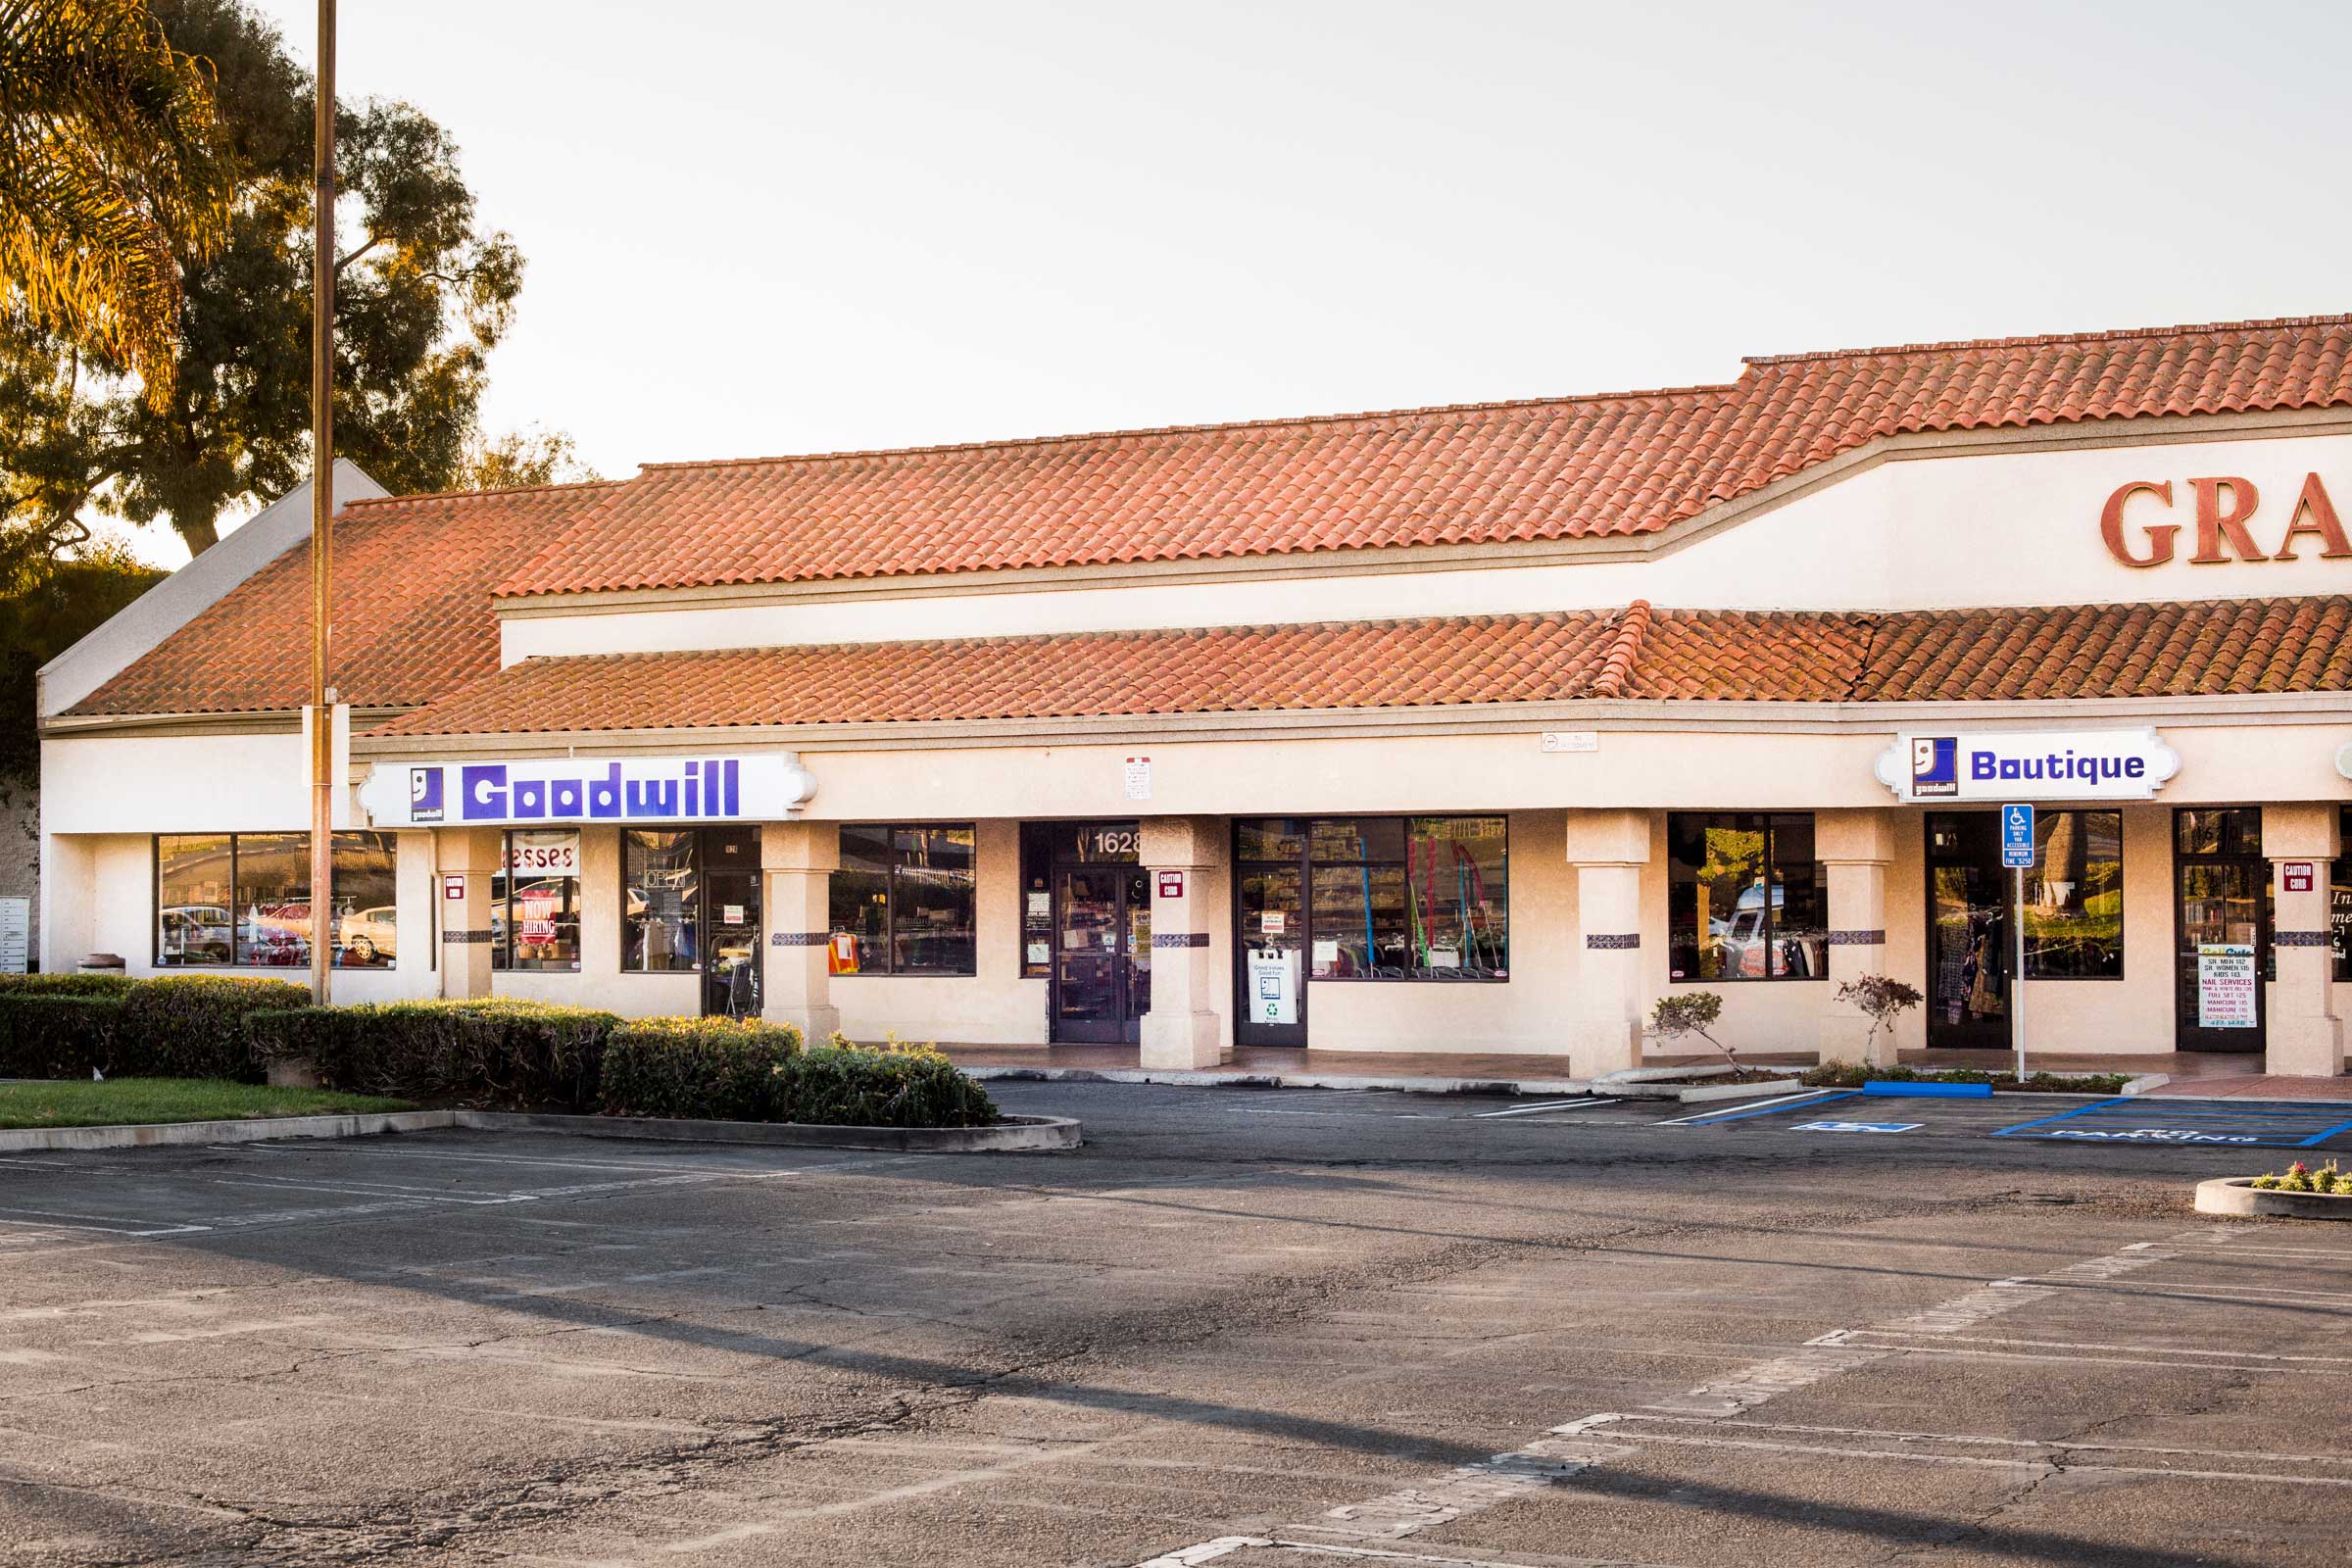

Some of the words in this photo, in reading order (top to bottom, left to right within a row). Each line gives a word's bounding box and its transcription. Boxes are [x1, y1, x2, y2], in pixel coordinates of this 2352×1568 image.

[2100, 471, 2352, 567] GRA
[1972, 750, 2145, 785] Boutique
[462, 760, 739, 820] Goodwill
[1916, 783, 1956, 796] goodwill
[2284, 864, 2312, 876] CAUTION
[446, 877, 464, 887] CAUTION
[646, 870, 685, 887] OPEN
[1159, 873, 1182, 884] CAUTION
[2289, 878, 2307, 890] CURB
[1163, 885, 1178, 897] CURB
[524, 900, 553, 919] NOW
[522, 919, 555, 934] HIRING
[2050, 1130, 2259, 1143] PARKING
